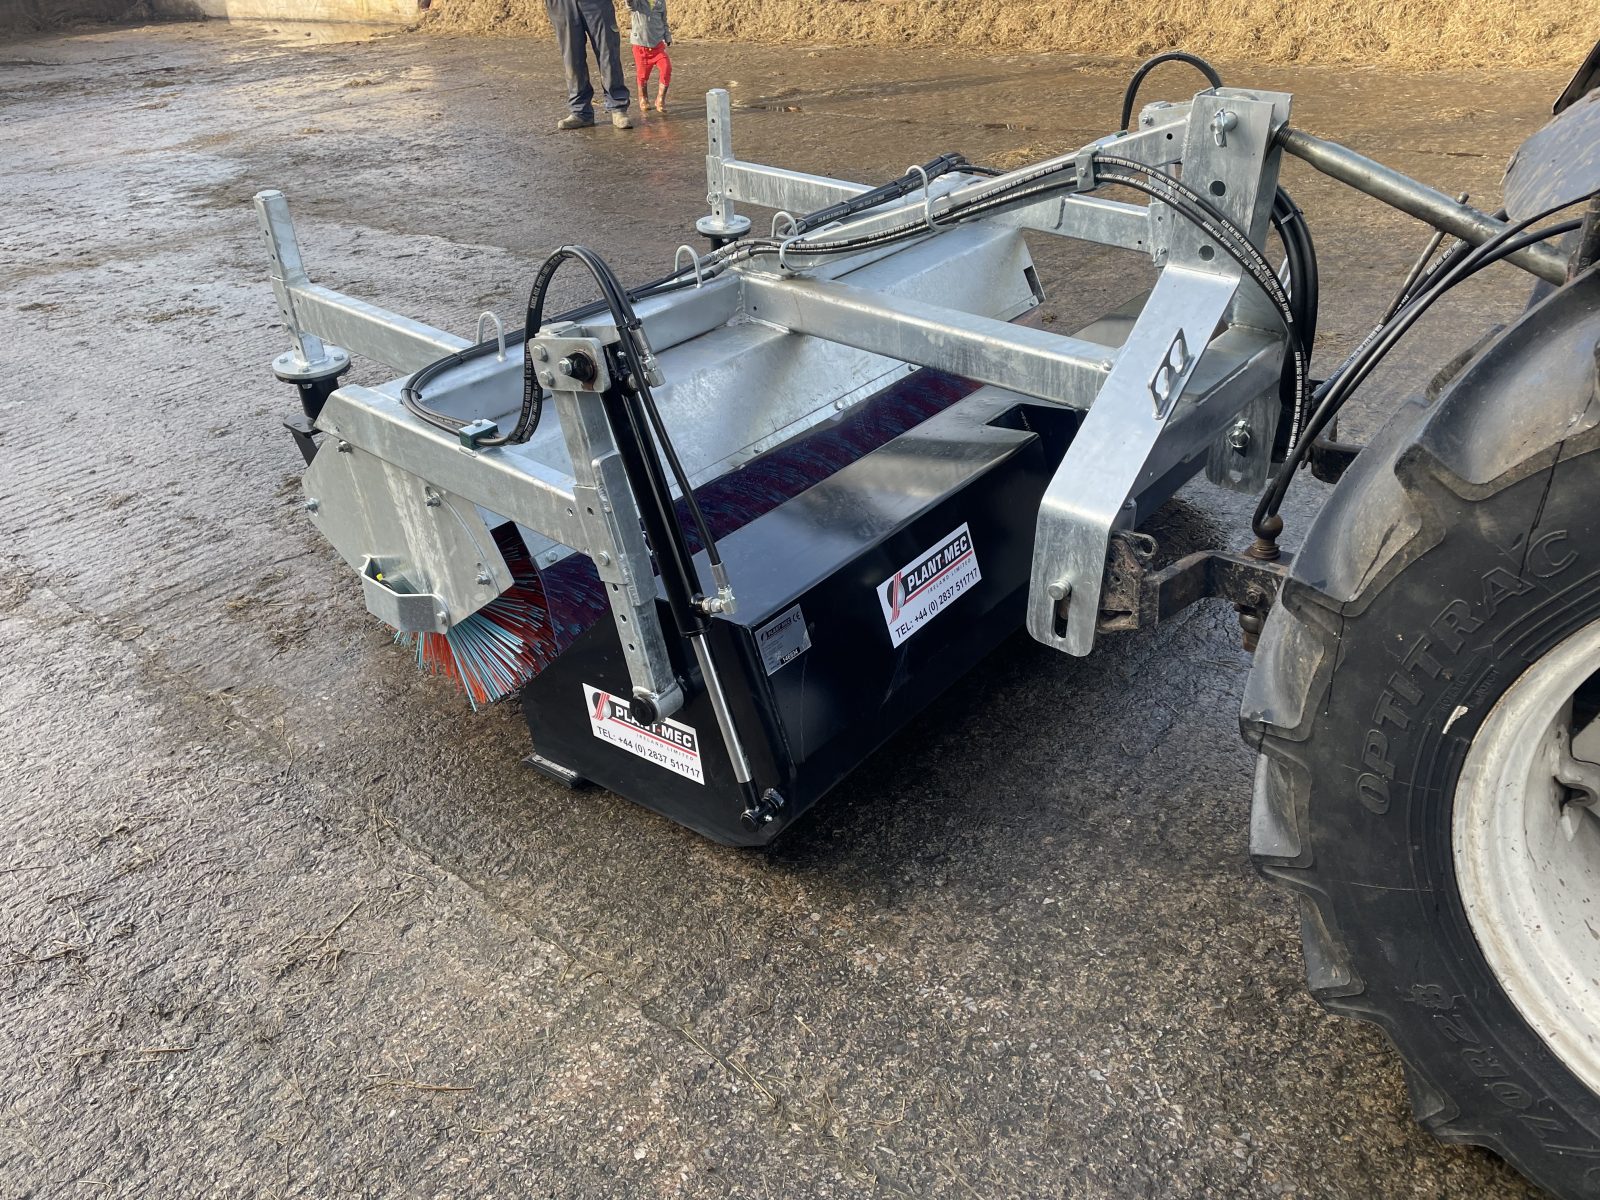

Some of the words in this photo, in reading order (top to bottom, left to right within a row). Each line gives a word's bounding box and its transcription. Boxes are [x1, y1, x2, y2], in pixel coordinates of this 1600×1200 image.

[907, 555, 942, 591] PLANT
[943, 535, 968, 564] MEC
[951, 558, 972, 577] LIMITED
[895, 620, 914, 638] TEL:
[914, 607, 928, 623] +44
[929, 600, 939, 616] (0)
[939, 586, 954, 606] 2837
[956, 567, 978, 592] 511717
[1356, 530, 1578, 814] OPTITRAC
[597, 726, 616, 740] TEL:
[618, 737, 633, 749] +44
[635, 743, 647, 757] (0)
[648, 748, 668, 764] 2837
[670, 758, 700, 778] 511717
[661, 724, 692, 748] MEC
[666, 746, 694, 761] LIMITED
